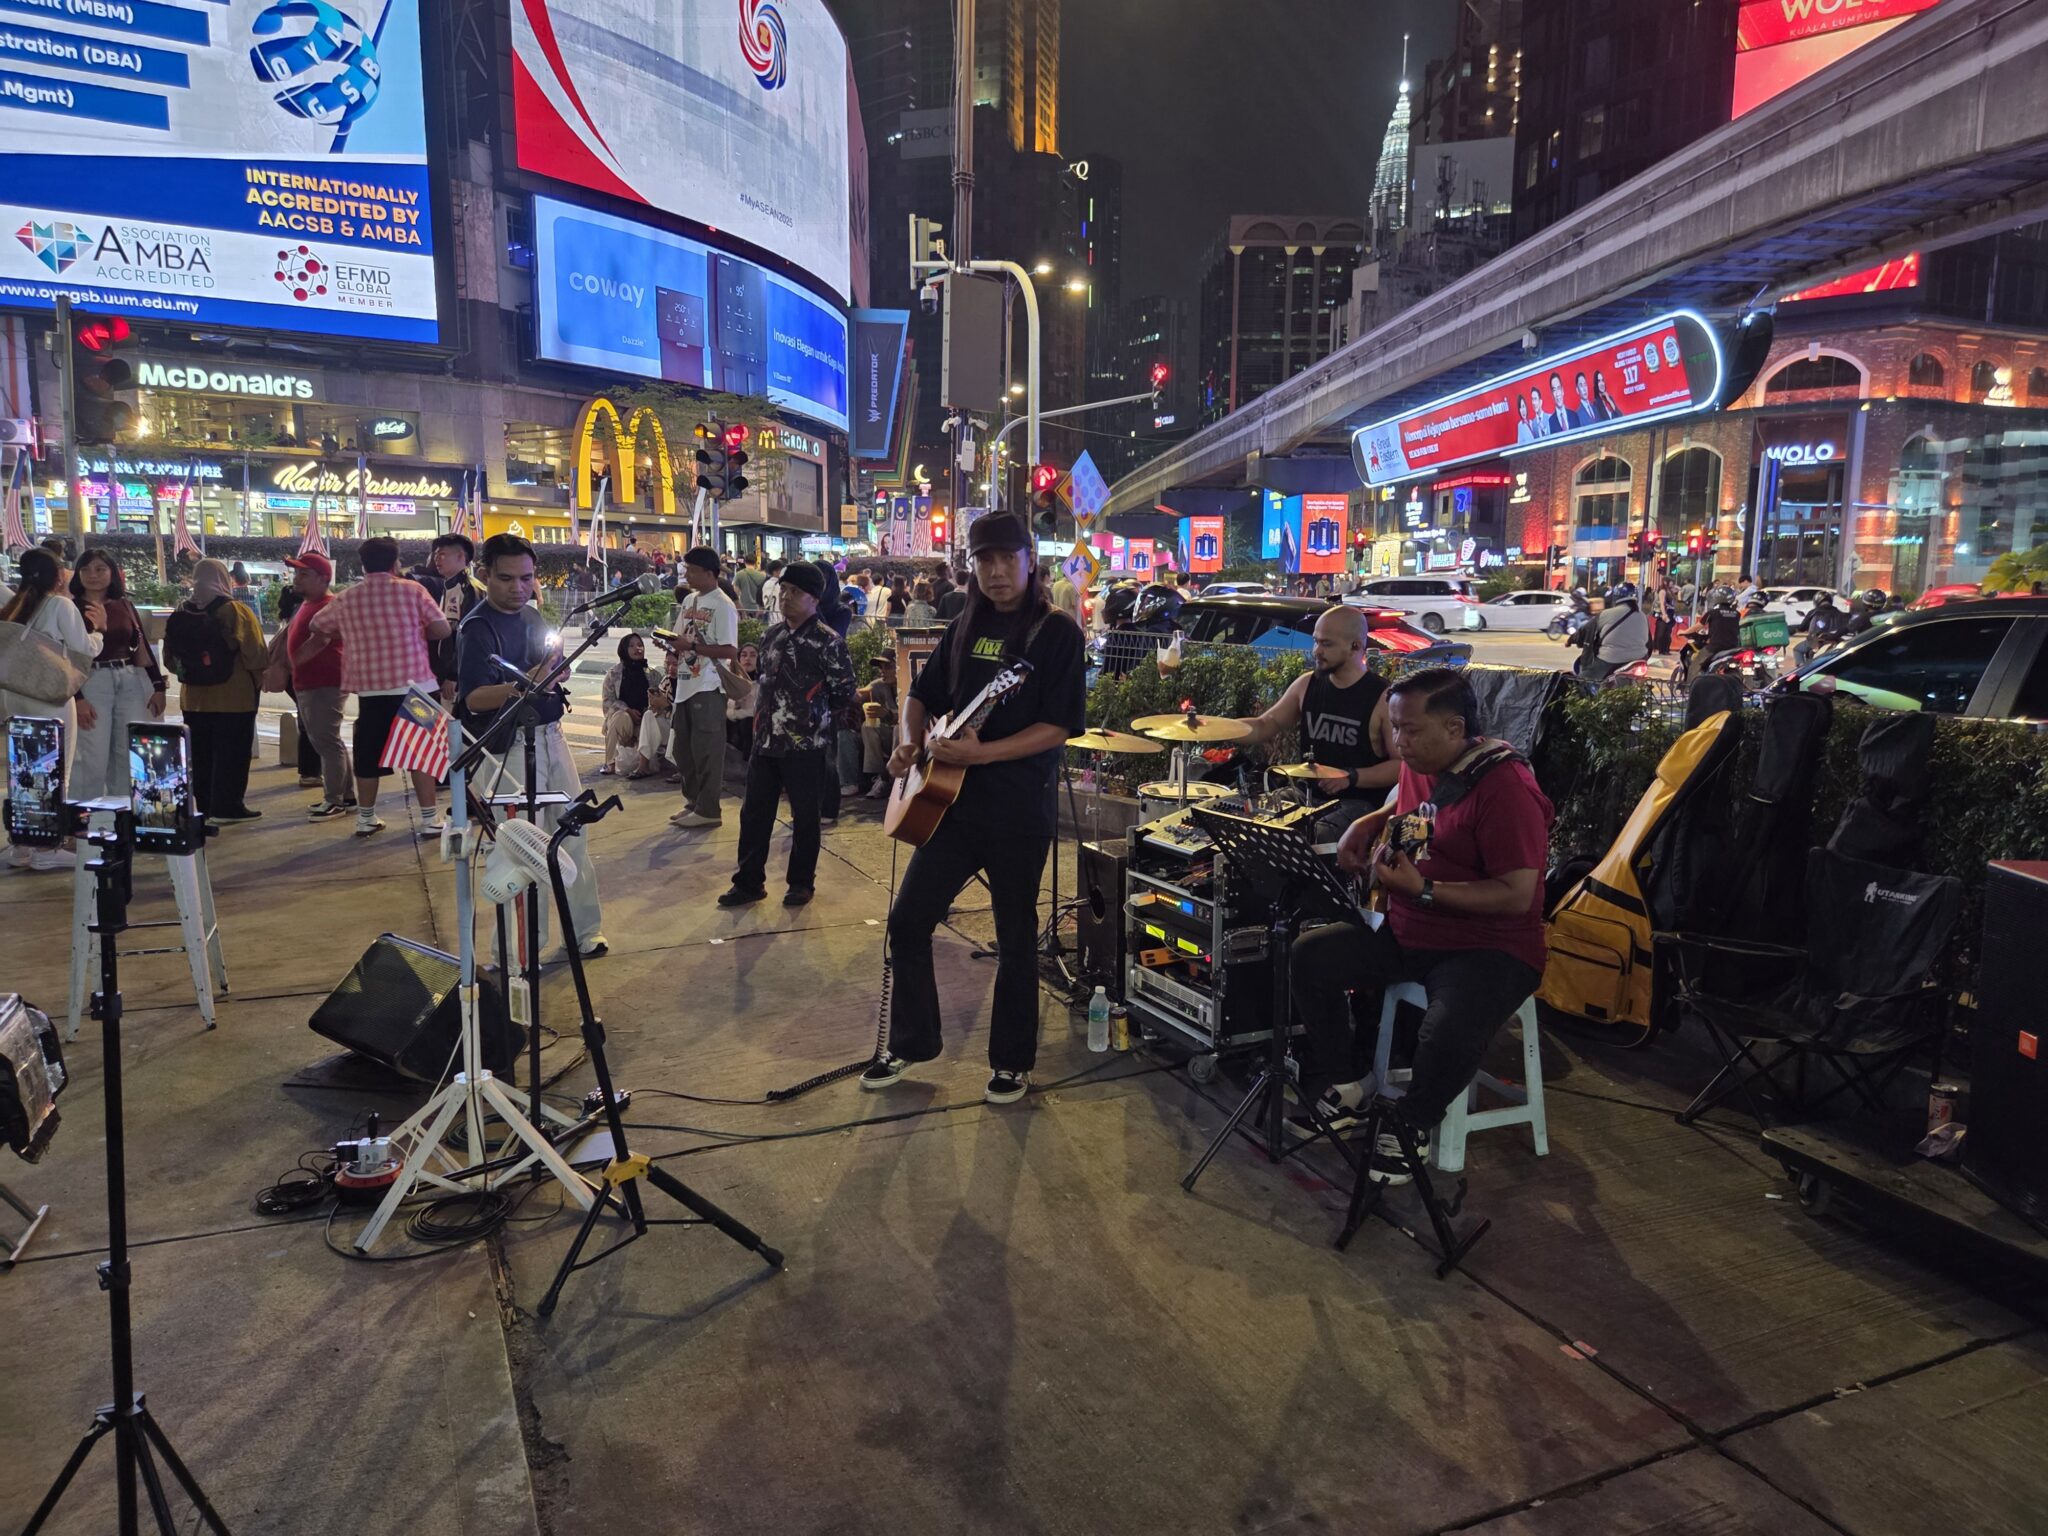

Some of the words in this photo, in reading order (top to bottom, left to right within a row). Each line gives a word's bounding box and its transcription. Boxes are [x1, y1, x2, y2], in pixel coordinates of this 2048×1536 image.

[66, 0, 134, 24] (MBM)
[1789, 22, 1828, 38] KUALA
[1831, 10, 1881, 28] LUMPUR
[83, 45, 142, 73] (DBA)
[246, 168, 419, 205] INTERNATIONALLY
[246, 187, 388, 221] ACCREDITED
[392, 207, 420, 225] BY
[740, 193, 793, 228] #MyASEAN2025
[258, 210, 335, 234] AACSB
[340, 220, 355, 237] &
[361, 223, 422, 245] AMBA
[96, 265, 215, 289] ACCREDITED
[335, 265, 390, 285] EFMD
[336, 281, 392, 296] GLOBAL
[569, 271, 645, 309] coway
[337, 296, 393, 308] MEMBER
[139, 362, 314, 399] McDonald's
[871, 353, 879, 408] PREDATOR
[1623, 364, 1639, 386] 117
[1376, 436, 1392, 450] Great
[1379, 448, 1400, 463] Eastern
[1767, 443, 1834, 462] WOLO
[1763, 630, 1784, 639] Grab
[1306, 711, 1361, 746] VANS
